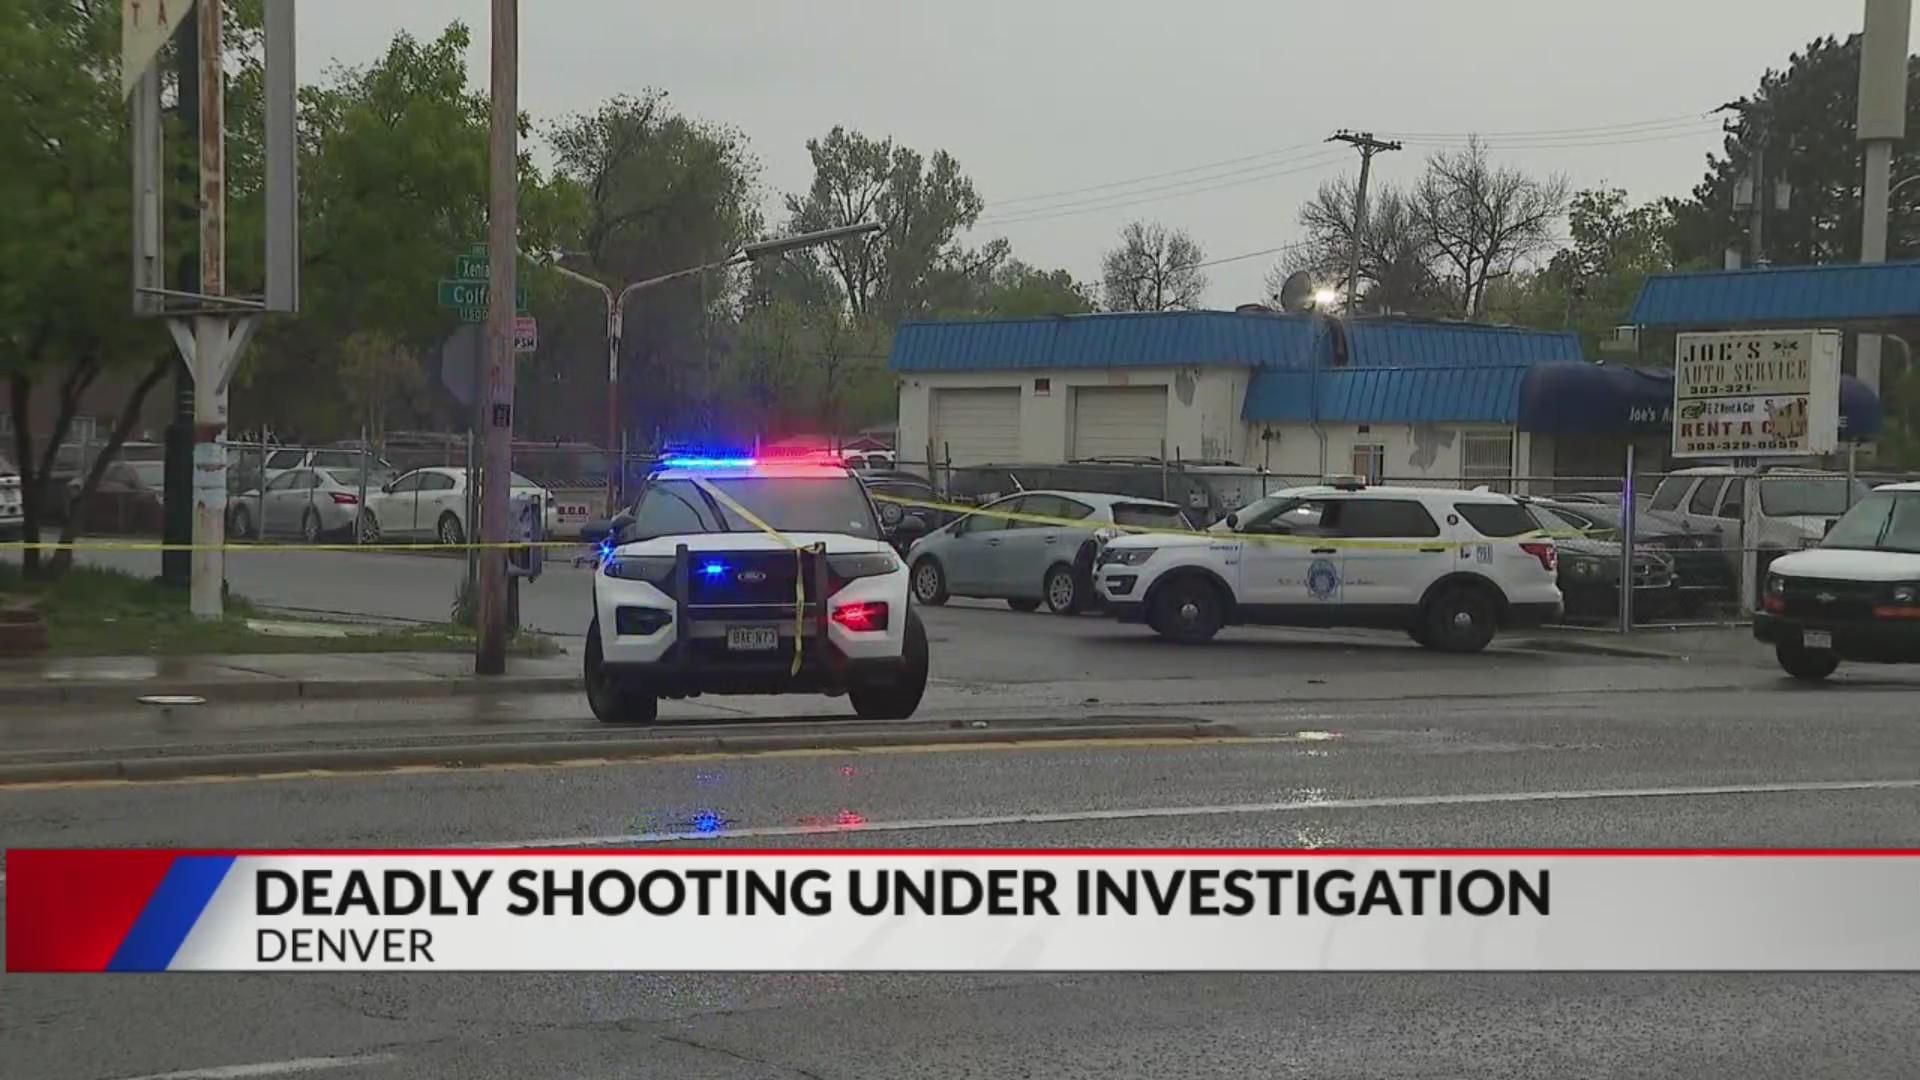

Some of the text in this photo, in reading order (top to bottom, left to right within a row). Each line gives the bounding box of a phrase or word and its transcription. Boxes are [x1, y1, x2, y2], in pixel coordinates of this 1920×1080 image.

[1683, 341, 1761, 362] JOE'S
[1682, 359, 1808, 384] AUTO SERVICE
[1629, 407, 1656, 422] Joe's
[1681, 422, 1732, 437] RENT
[1740, 421, 1752, 435] A
